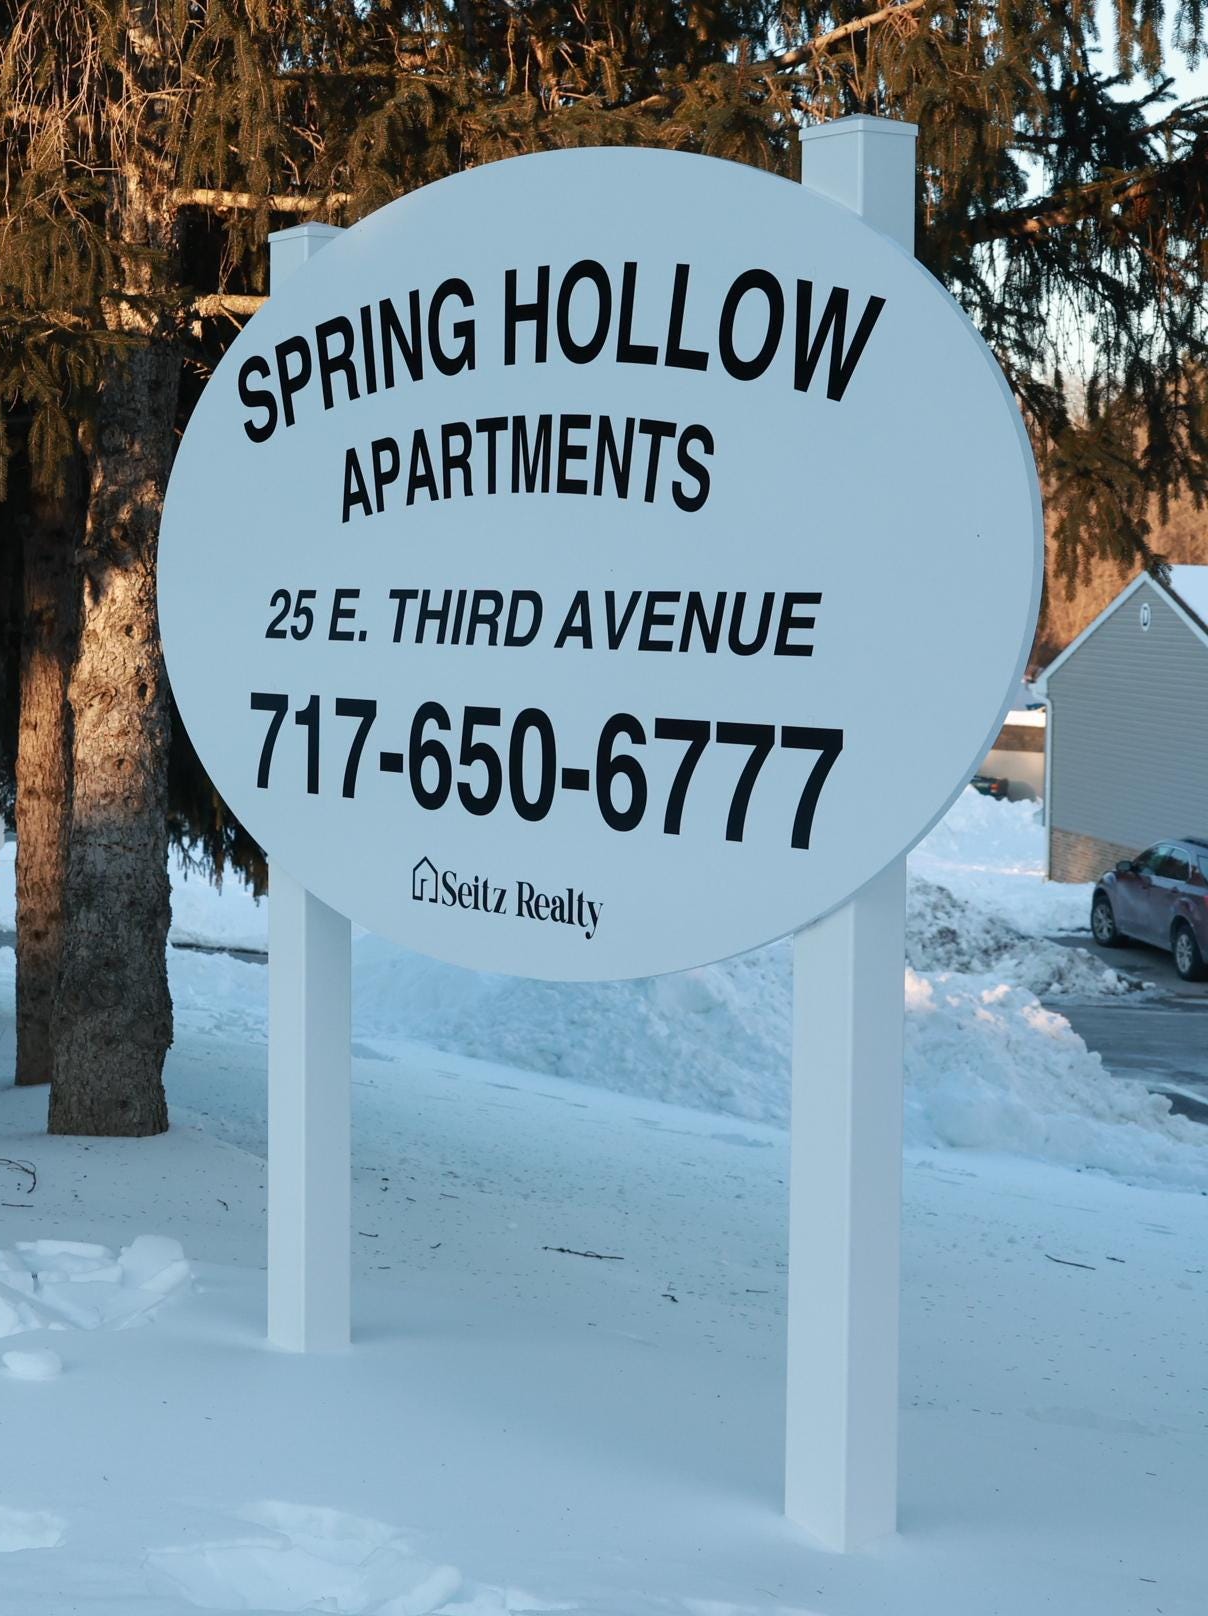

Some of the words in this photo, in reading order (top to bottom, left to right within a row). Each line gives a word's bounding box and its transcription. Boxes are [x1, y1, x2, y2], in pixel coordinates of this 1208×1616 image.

[238, 277, 476, 444] SPRING
[503, 259, 887, 403] HOLLOW
[341, 413, 715, 524] APARTMENTS
[264, 588, 318, 641] 25
[328, 588, 369, 642] E.
[388, 588, 544, 648] THIRD
[553, 590, 823, 657] AVENUE
[250, 691, 844, 850] 717-650-6777
[441, 870, 507, 915] Seitz
[515, 880, 604, 940] Realty
